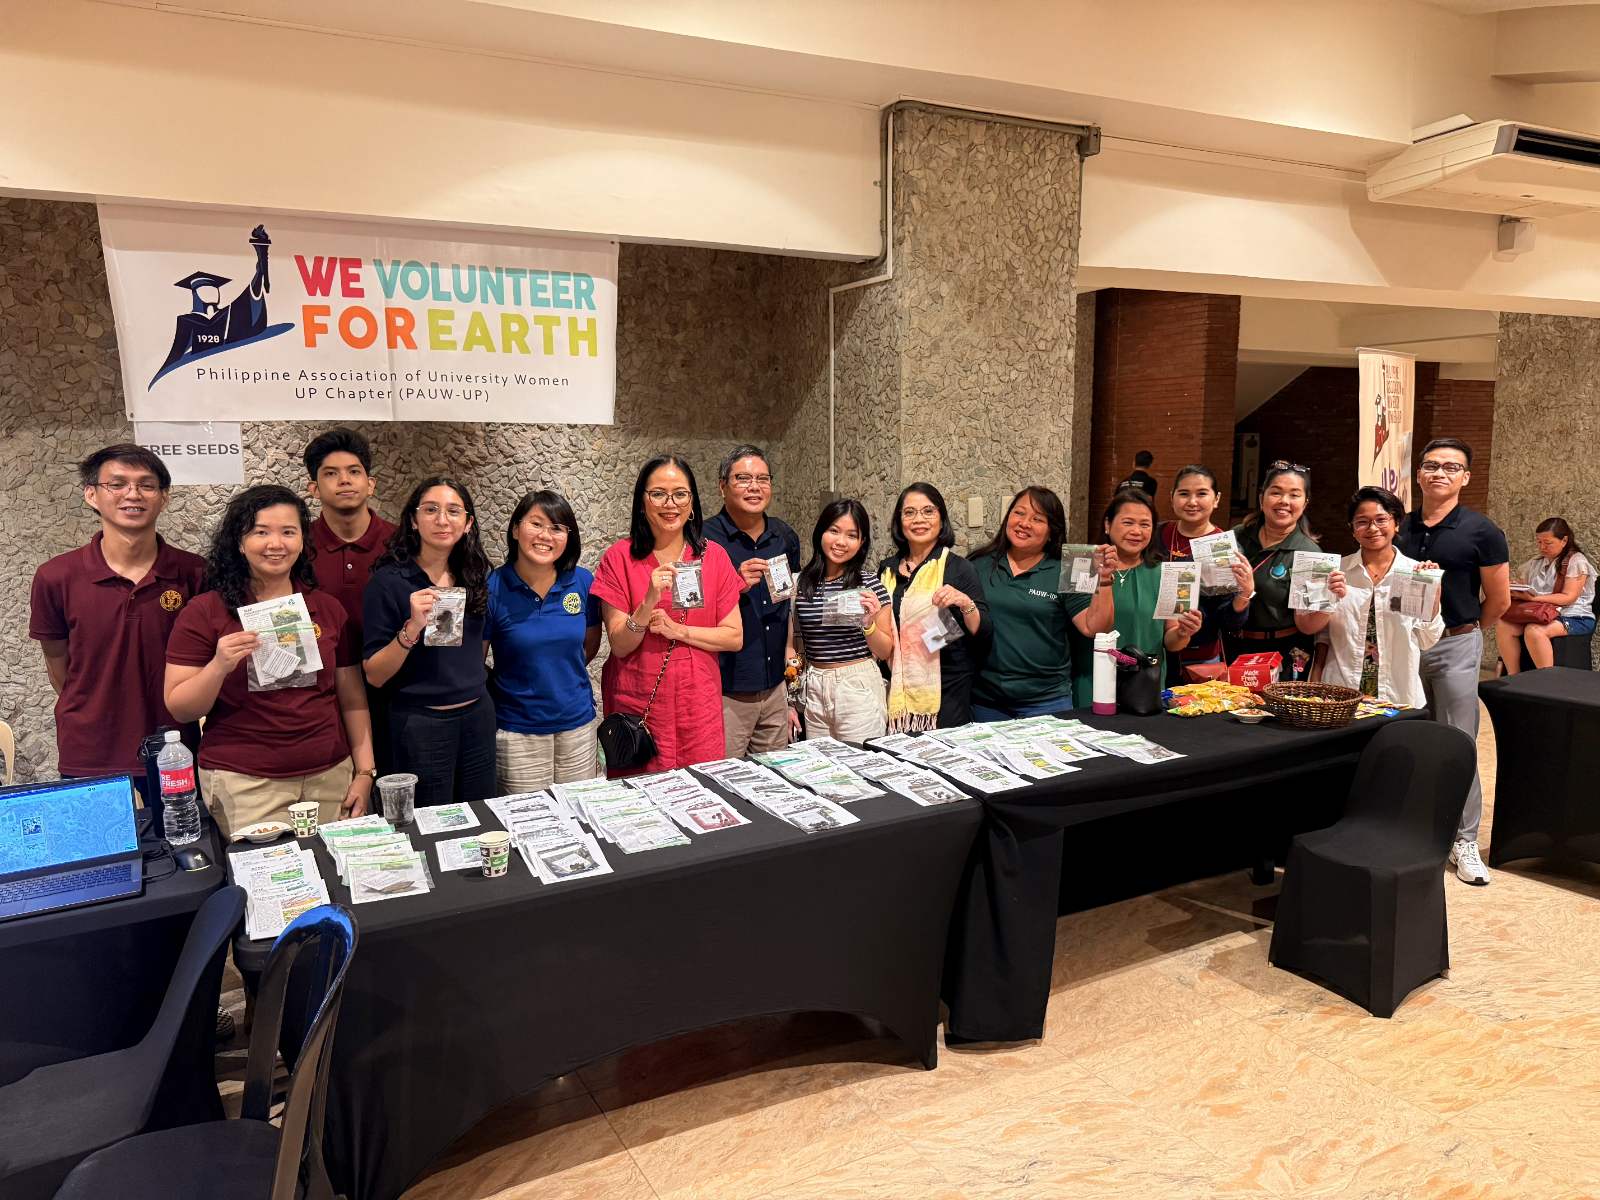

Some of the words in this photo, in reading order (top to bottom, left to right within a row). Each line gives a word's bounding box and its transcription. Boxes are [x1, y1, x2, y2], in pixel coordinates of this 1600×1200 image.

[294, 254, 366, 299] WE
[373, 257, 597, 311] VOLUNTEER
[302, 303, 418, 350] FOR
[427, 307, 599, 358] EARTH
[197, 334, 220, 343] 1928
[196, 367, 291, 384] Philippine
[298, 368, 398, 382] Association
[405, 369, 422, 382] of
[428, 370, 508, 387] University
[514, 373, 569, 387] Women
[295, 387, 318, 399] UP
[325, 387, 393, 402] Chapter
[399, 388, 490, 402] (PAUW-UP)
[186, 443, 240, 455] SEEDS
[161, 778, 188, 787] FRESH
